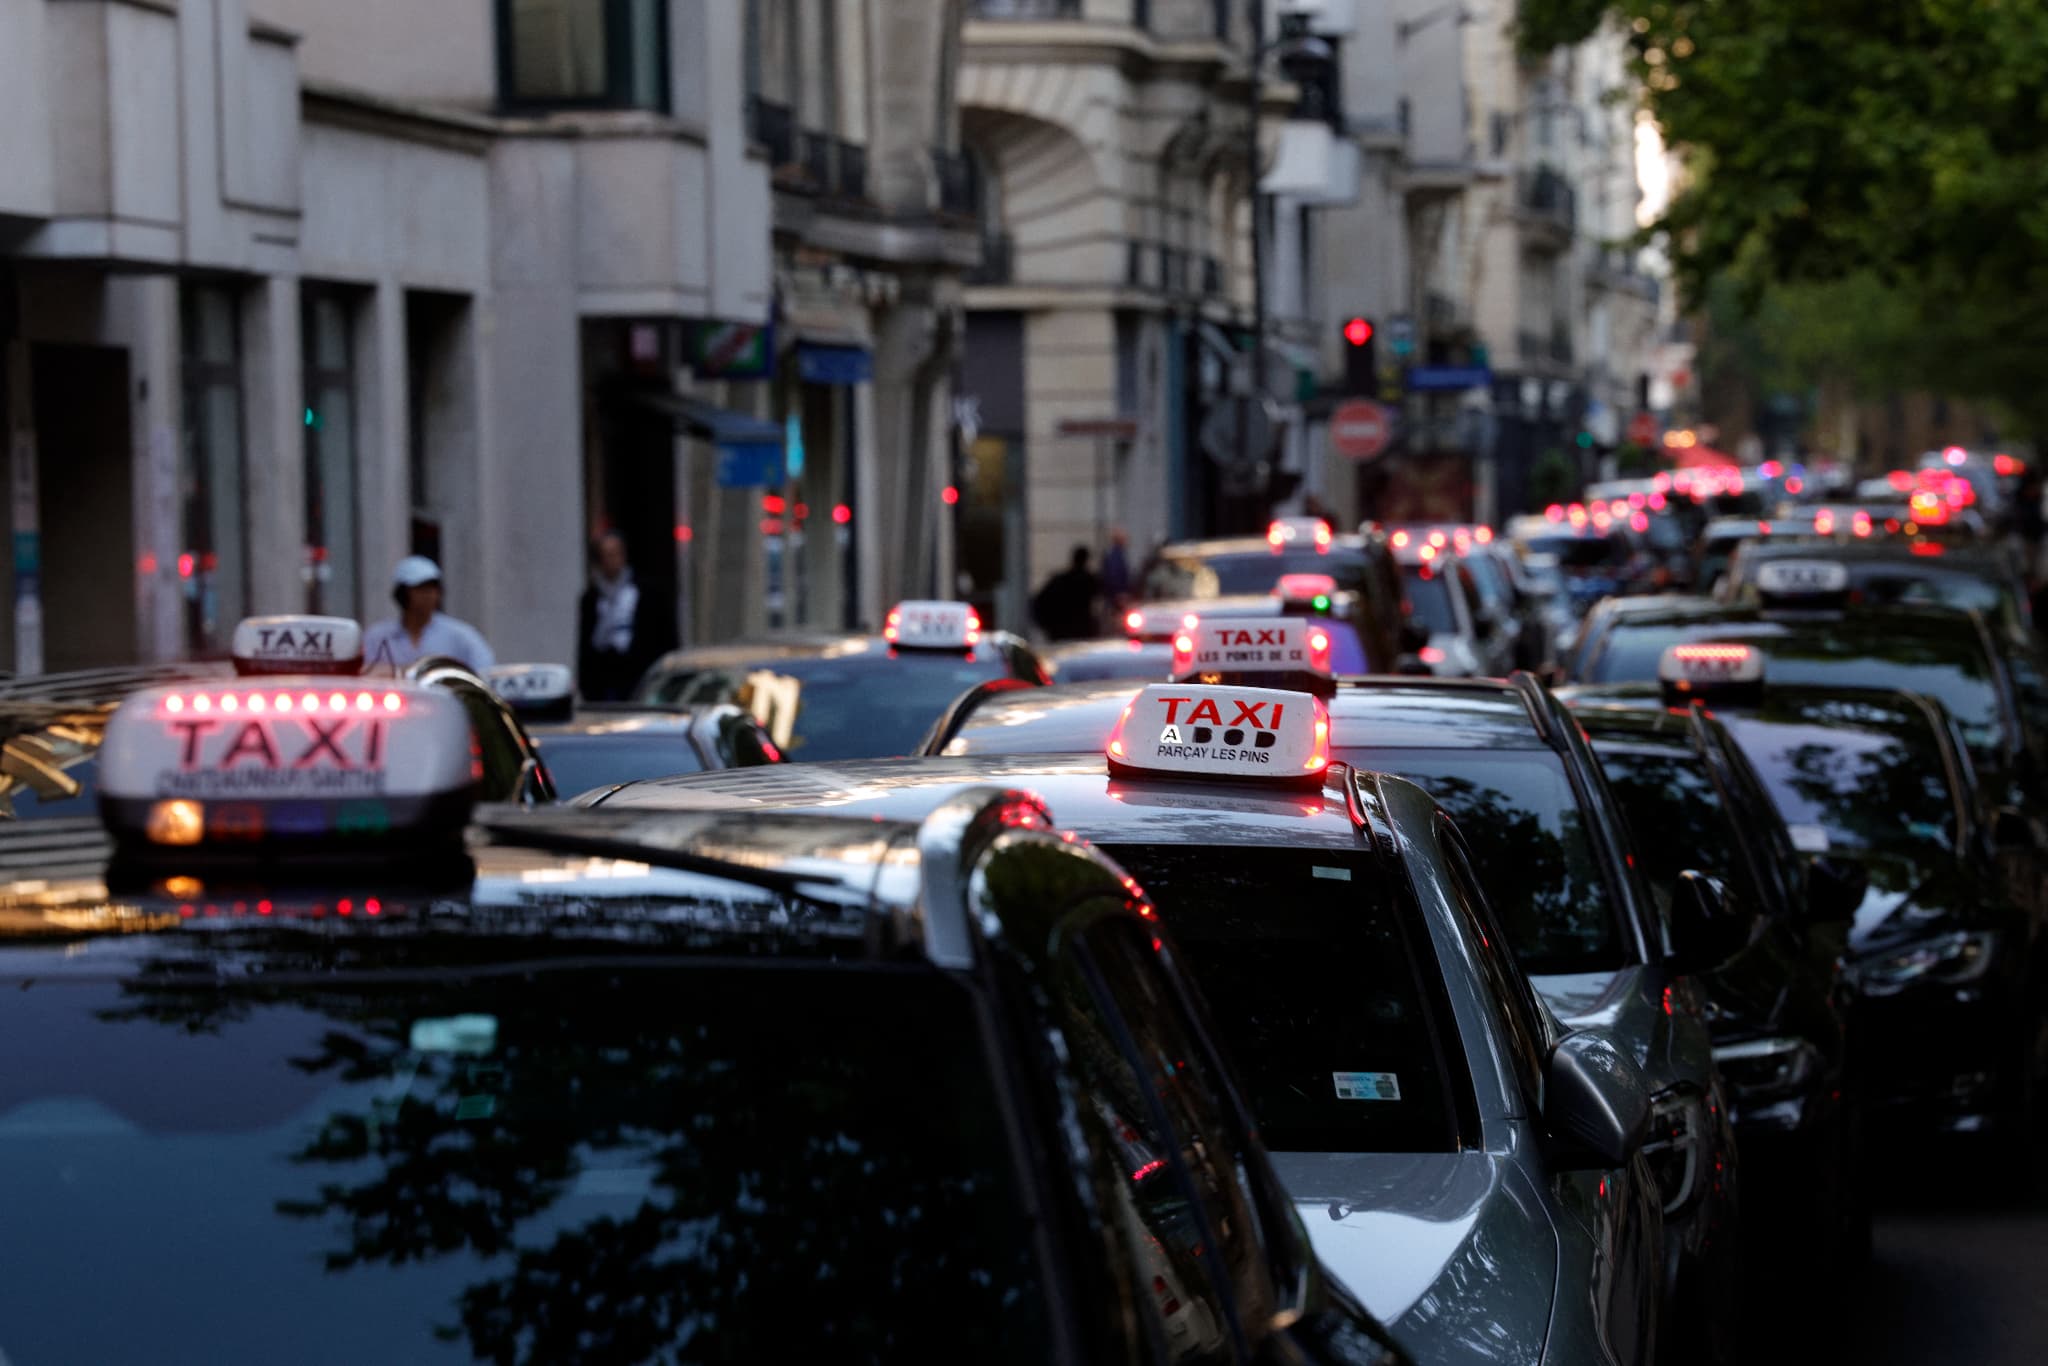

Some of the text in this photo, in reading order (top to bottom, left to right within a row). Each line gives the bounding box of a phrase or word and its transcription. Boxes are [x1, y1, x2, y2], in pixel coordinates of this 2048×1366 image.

[259, 628, 333, 649] TAXI
[1215, 629, 1286, 645] TAXI
[1198, 651, 1219, 662] LES
[1157, 697, 1284, 730] TAXI
[170, 718, 388, 768] TAXI
[1160, 724, 1183, 744] A
[1157, 745, 1270, 764] PARÇAY LES PINS
